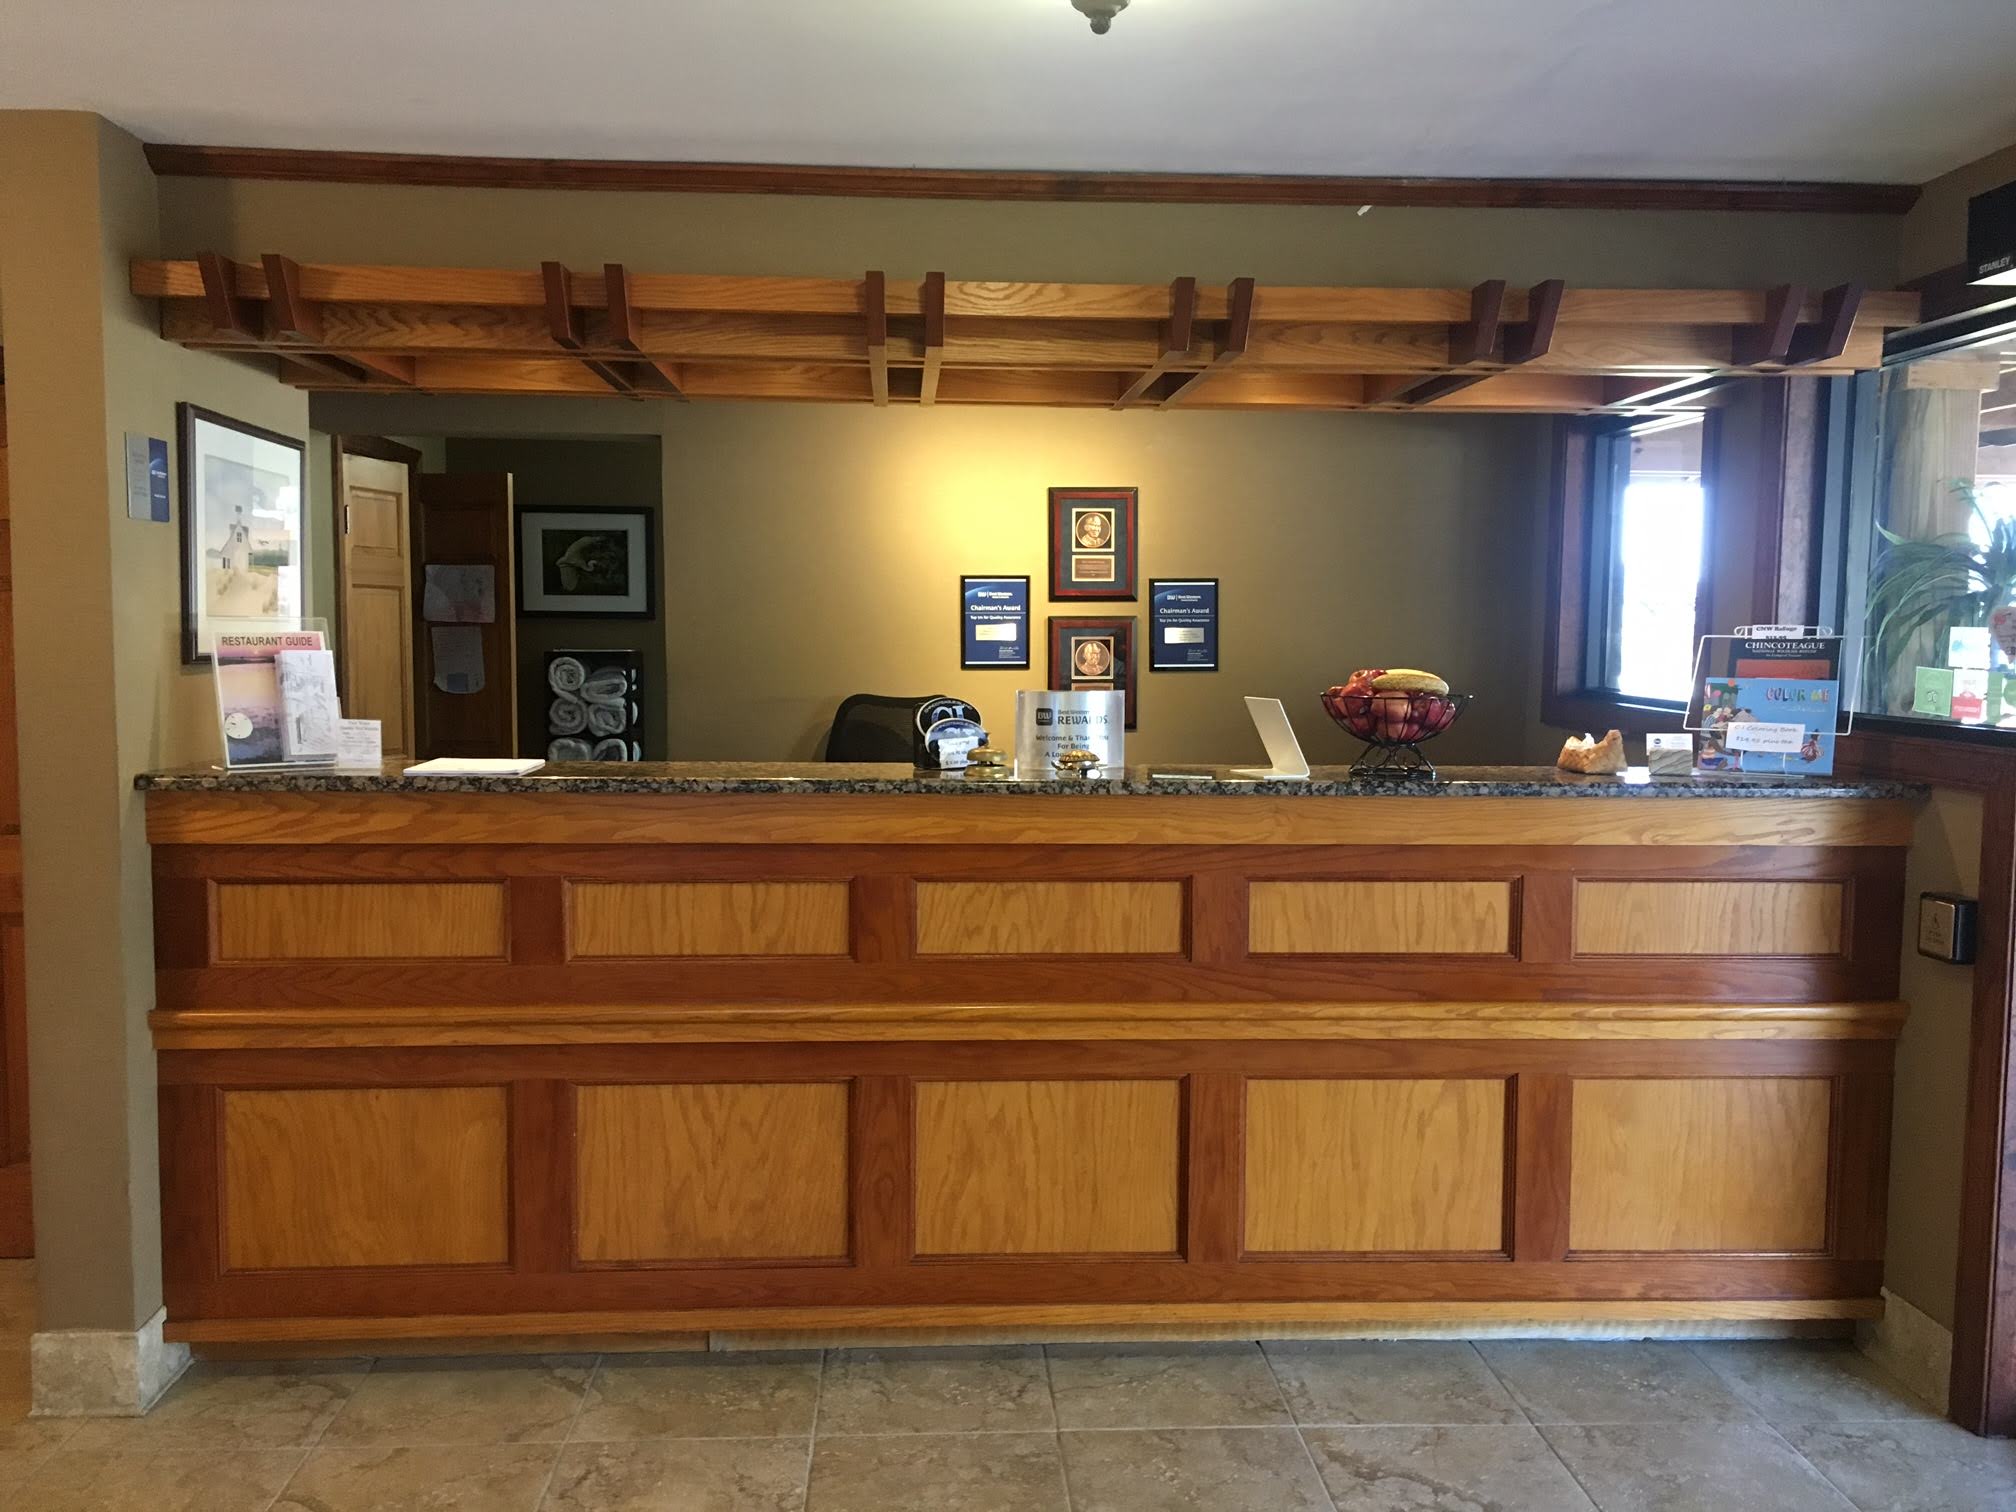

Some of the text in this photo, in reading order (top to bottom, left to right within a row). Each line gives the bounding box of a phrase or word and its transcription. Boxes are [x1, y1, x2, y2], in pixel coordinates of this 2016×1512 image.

[1979, 256, 2011, 274] STANLEY
[221, 635, 313, 648] RESTAURANT GUIDE
[1745, 641, 1825, 649] CHINCOTEAGUE
[1766, 686, 1806, 702] COLOR
